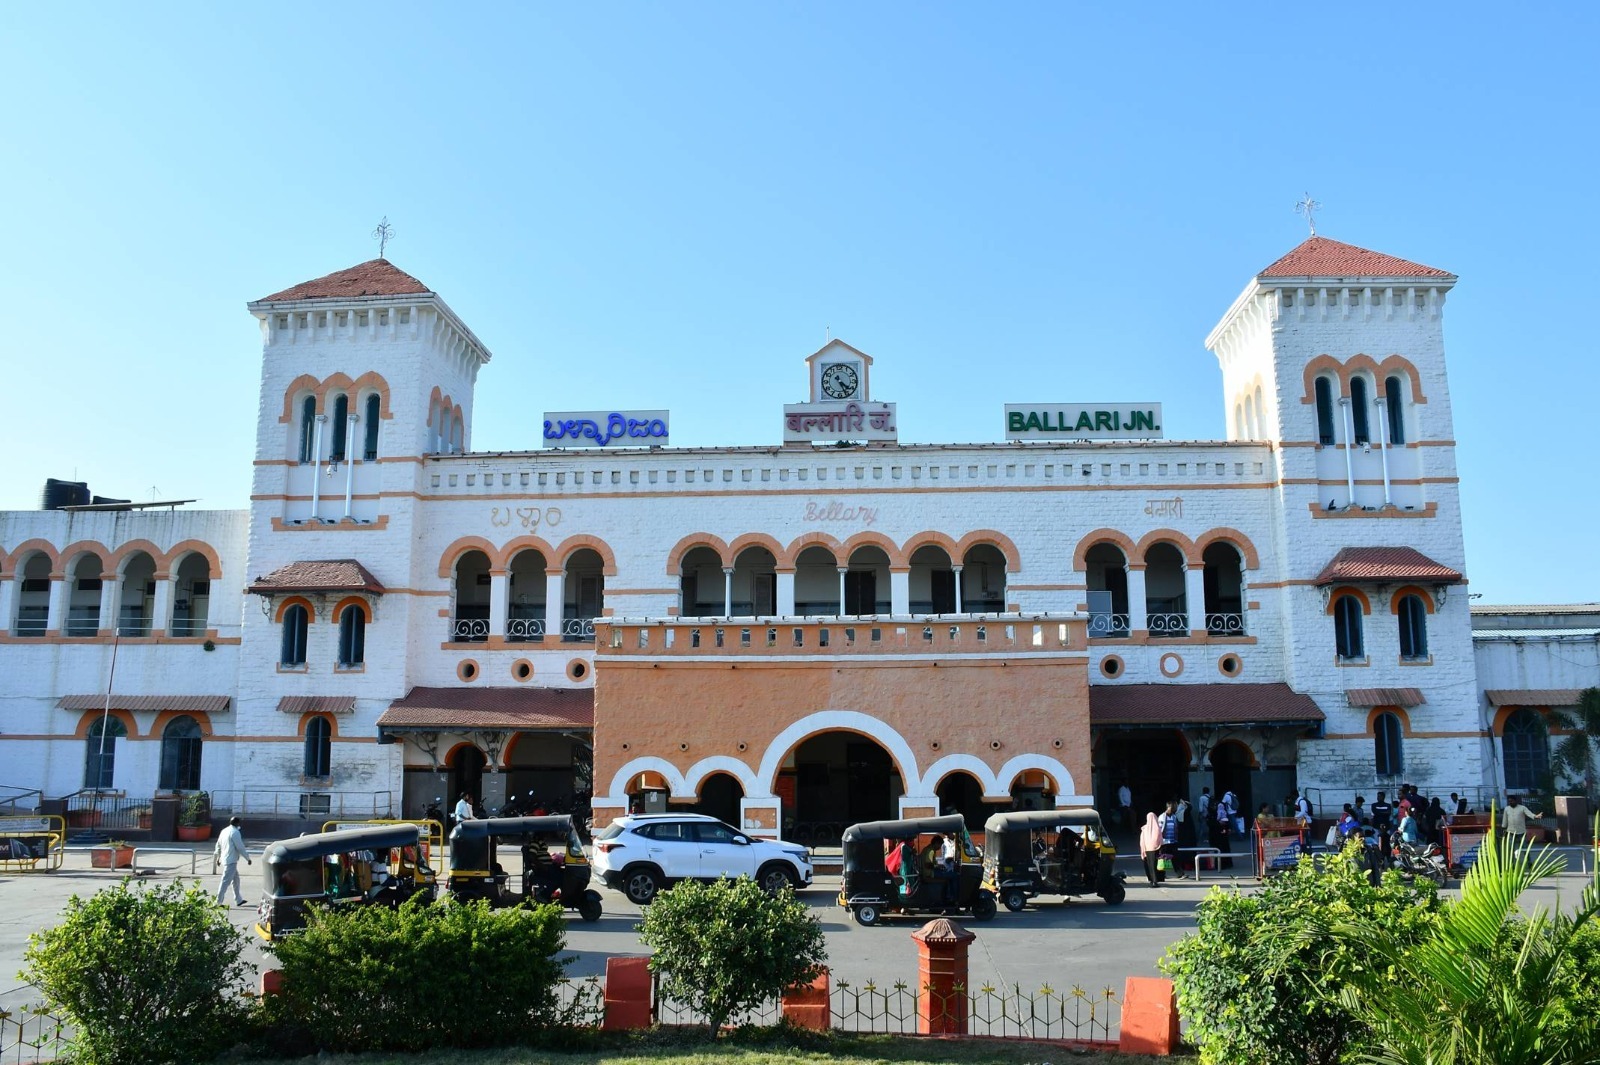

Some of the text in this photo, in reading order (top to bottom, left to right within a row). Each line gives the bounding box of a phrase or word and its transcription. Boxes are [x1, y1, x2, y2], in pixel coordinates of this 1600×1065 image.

[785, 403, 865, 432] बल्लारि
[1008, 410, 1160, 432] BALLARI JN.
[803, 500, 878, 527] Bellary
